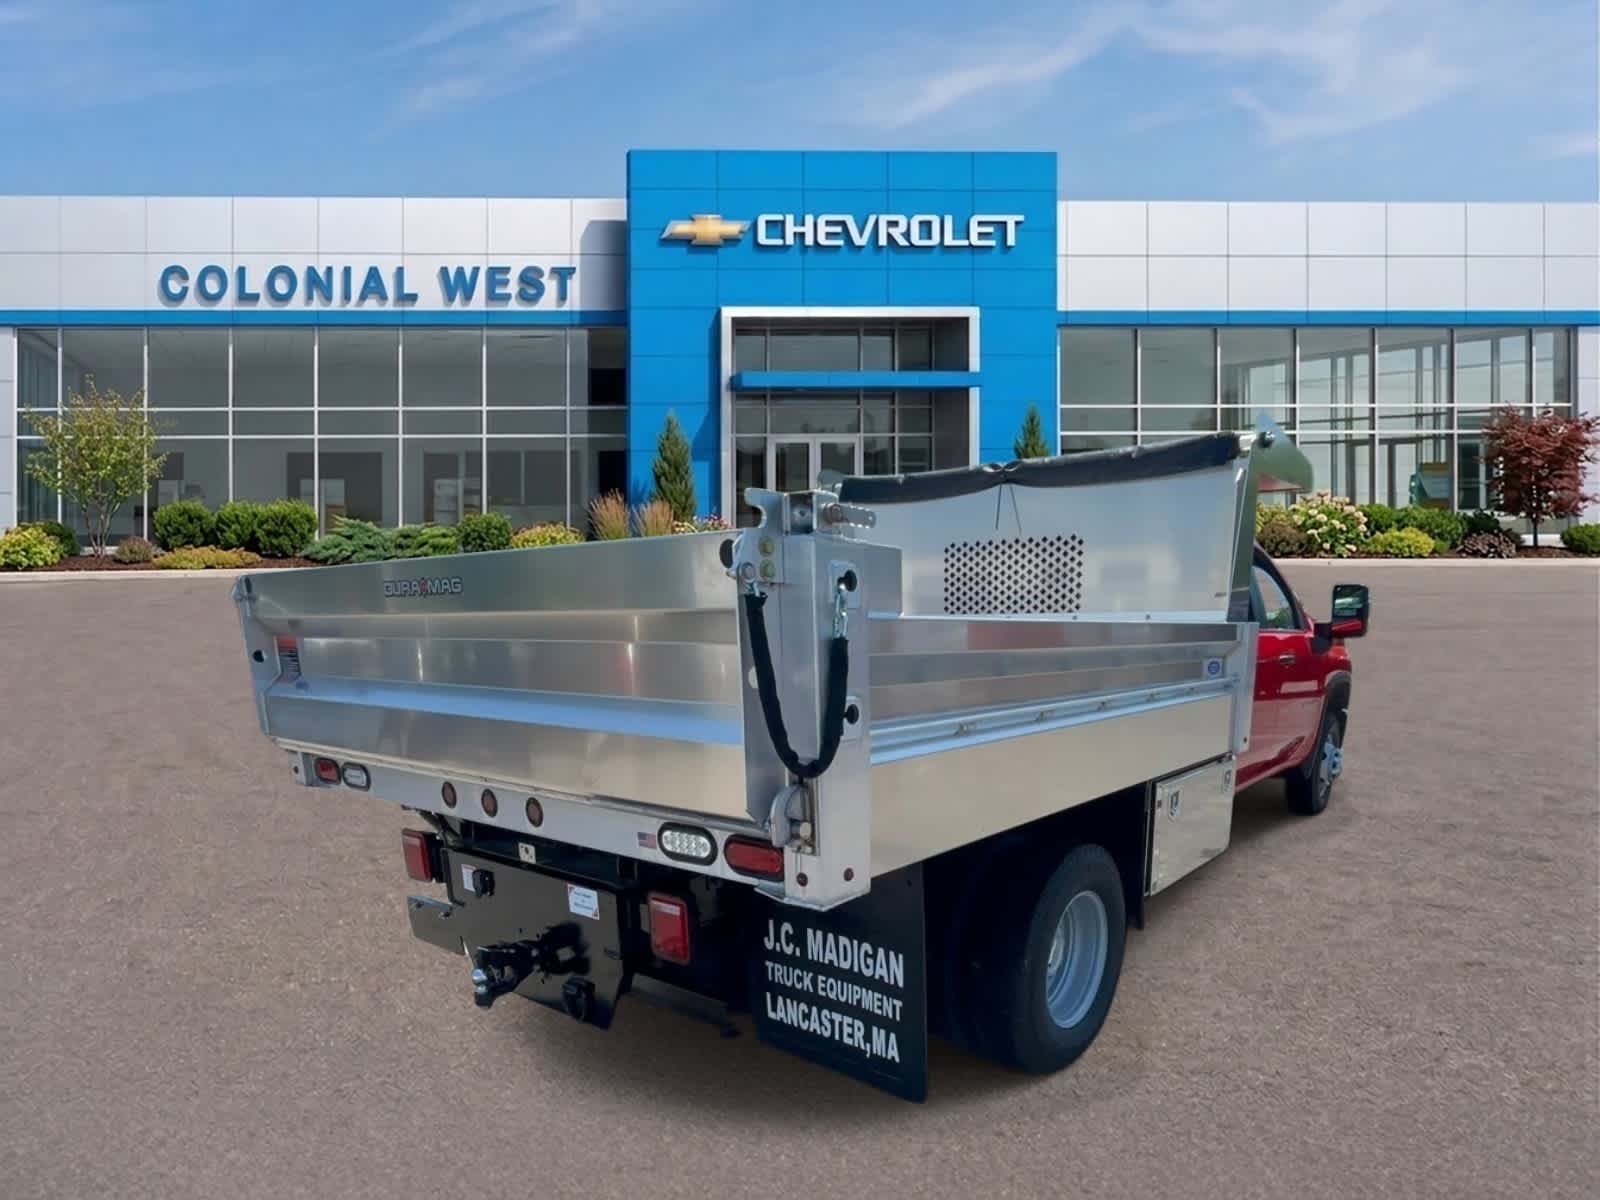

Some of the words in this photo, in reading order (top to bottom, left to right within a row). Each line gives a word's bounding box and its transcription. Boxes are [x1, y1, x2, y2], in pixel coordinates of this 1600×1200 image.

[755, 213, 1025, 248] CHEVROLET
[160, 264, 419, 303] COLONIAL
[438, 264, 577, 303] WEST
[764, 919, 801, 957] J.C.
[806, 928, 904, 988] MADIGAN
[765, 960, 814, 993] TRUCK
[817, 974, 903, 1022] EQUIPMENT
